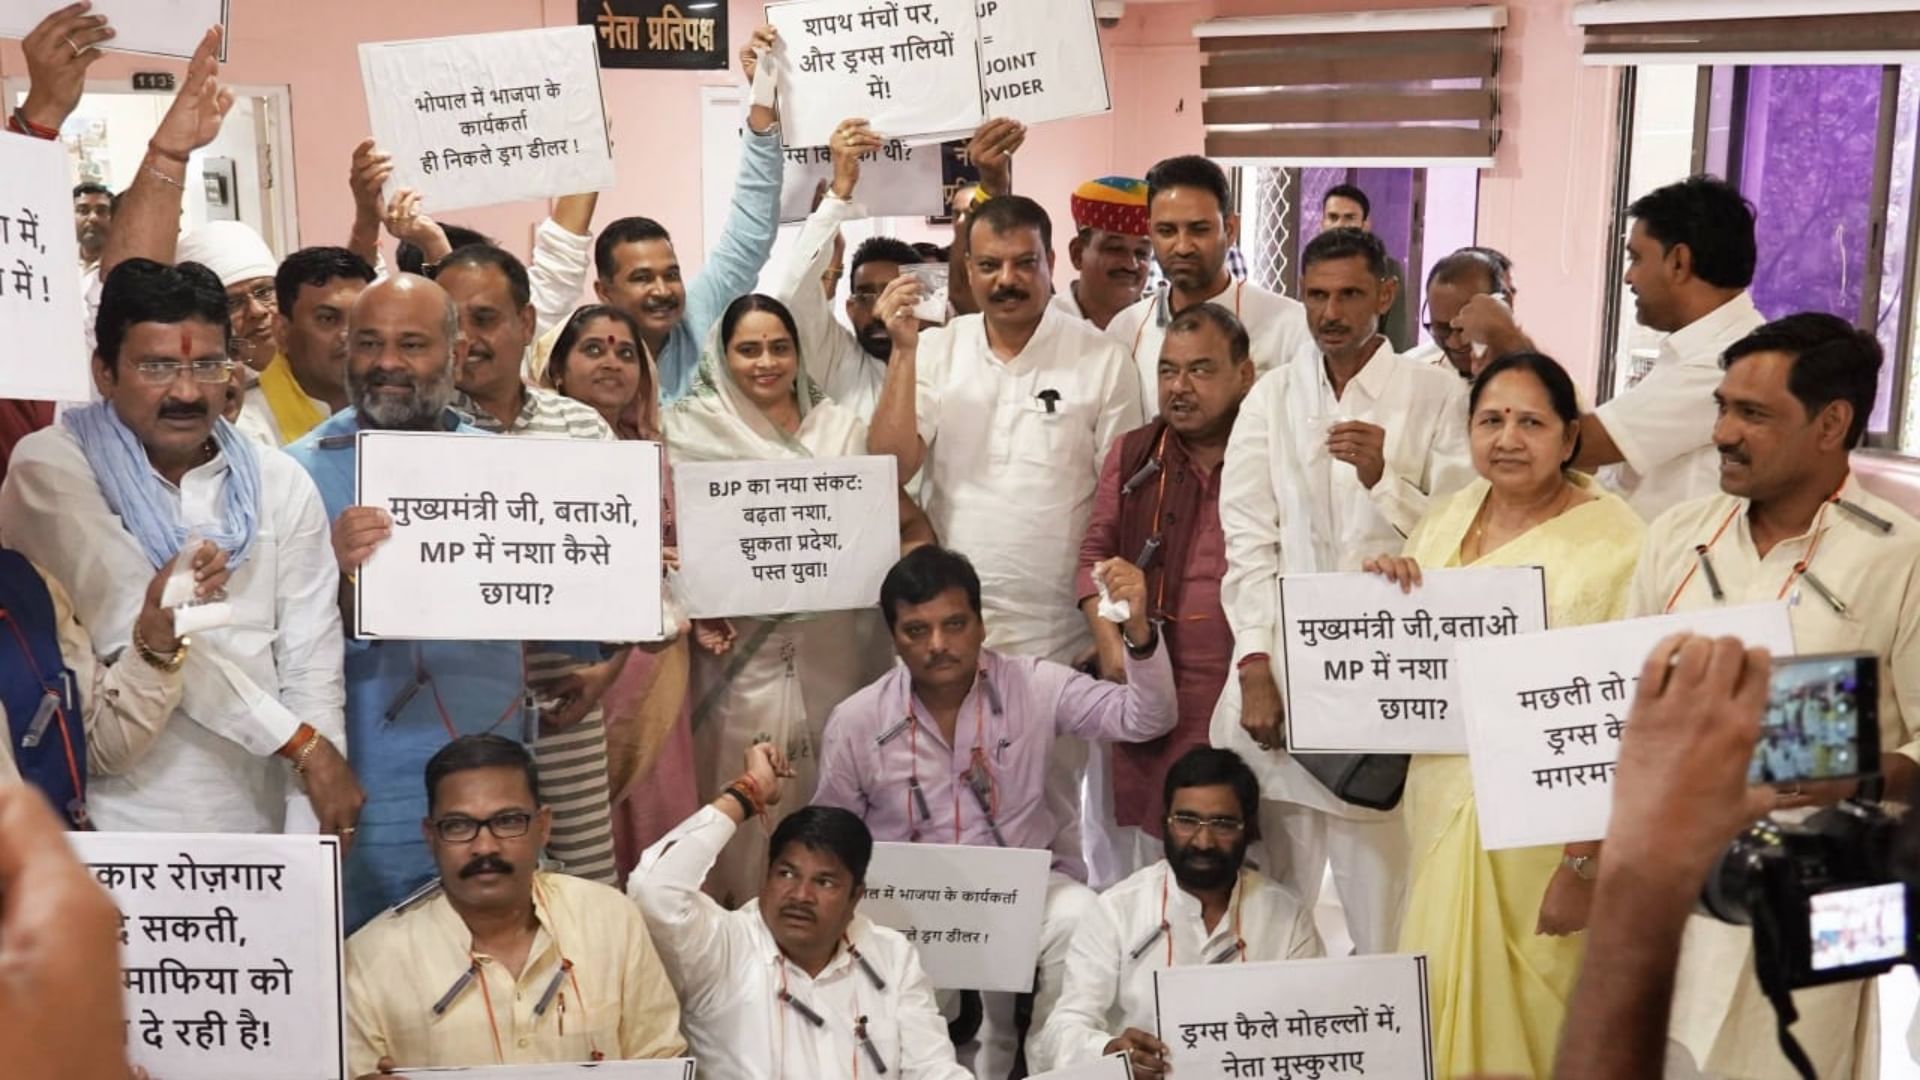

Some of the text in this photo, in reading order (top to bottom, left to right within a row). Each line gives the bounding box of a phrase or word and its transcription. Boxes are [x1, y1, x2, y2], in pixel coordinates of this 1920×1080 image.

[803, 1, 939, 36] शपथ मंचों पर,
[976, 1, 997, 18] JP
[597, 1, 715, 51] नेता प्रतिपक्ष
[800, 31, 954, 73] और ड्रग्स गलियों
[986, 52, 1036, 75] JOINT
[415, 78, 561, 113] भोपाल में भाजपा के
[867, 75, 891, 99] में!
[459, 109, 528, 137] कार्यकर्ता
[420, 151, 439, 174] ही
[443, 144, 492, 170] निकले
[496, 146, 522, 168] ड्रग
[526, 137, 568, 158] डीलर
[17, 208, 46, 254] में,
[11, 259, 33, 300] में
[709, 473, 863, 497] BJP का नया संकट:
[389, 491, 638, 527] मुख्यमंत्री जी, बताओ,
[791, 504, 831, 521] नशा,
[420, 533, 611, 565] MP में नशा कैसे
[739, 528, 842, 560] झुकता प्रदेश,
[752, 563, 828, 583] पस्त युवा!
[480, 582, 554, 605] छाया?
[1297, 610, 1395, 646] मुख्यमंत्री
[1324, 651, 1448, 680] MP में नशा
[1517, 671, 1625, 710] मछली तो
[1378, 699, 1448, 720] छाया?
[1544, 724, 1597, 755] ड्रग्स
[1532, 761, 1618, 790] मगरम
[168, 853, 285, 892] रोज़गार
[883, 885, 895, 899] में
[899, 889, 940, 901] भाजपा
[944, 887, 958, 902] के
[962, 888, 1018, 904] कार्यकर्ता
[139, 906, 246, 947] सकती,
[921, 931, 942, 944] ड्रग
[946, 928, 980, 943] डीलर
[122, 957, 293, 995] माफिया को
[140, 1009, 164, 1049] दे
[173, 1010, 227, 1050] रही
[236, 1009, 270, 1050] है!
[1179, 1004, 1401, 1049] ड्रग्स फैले मोहल्लों में,
[1222, 1051, 1365, 1080] नेता मुस्कुराए
